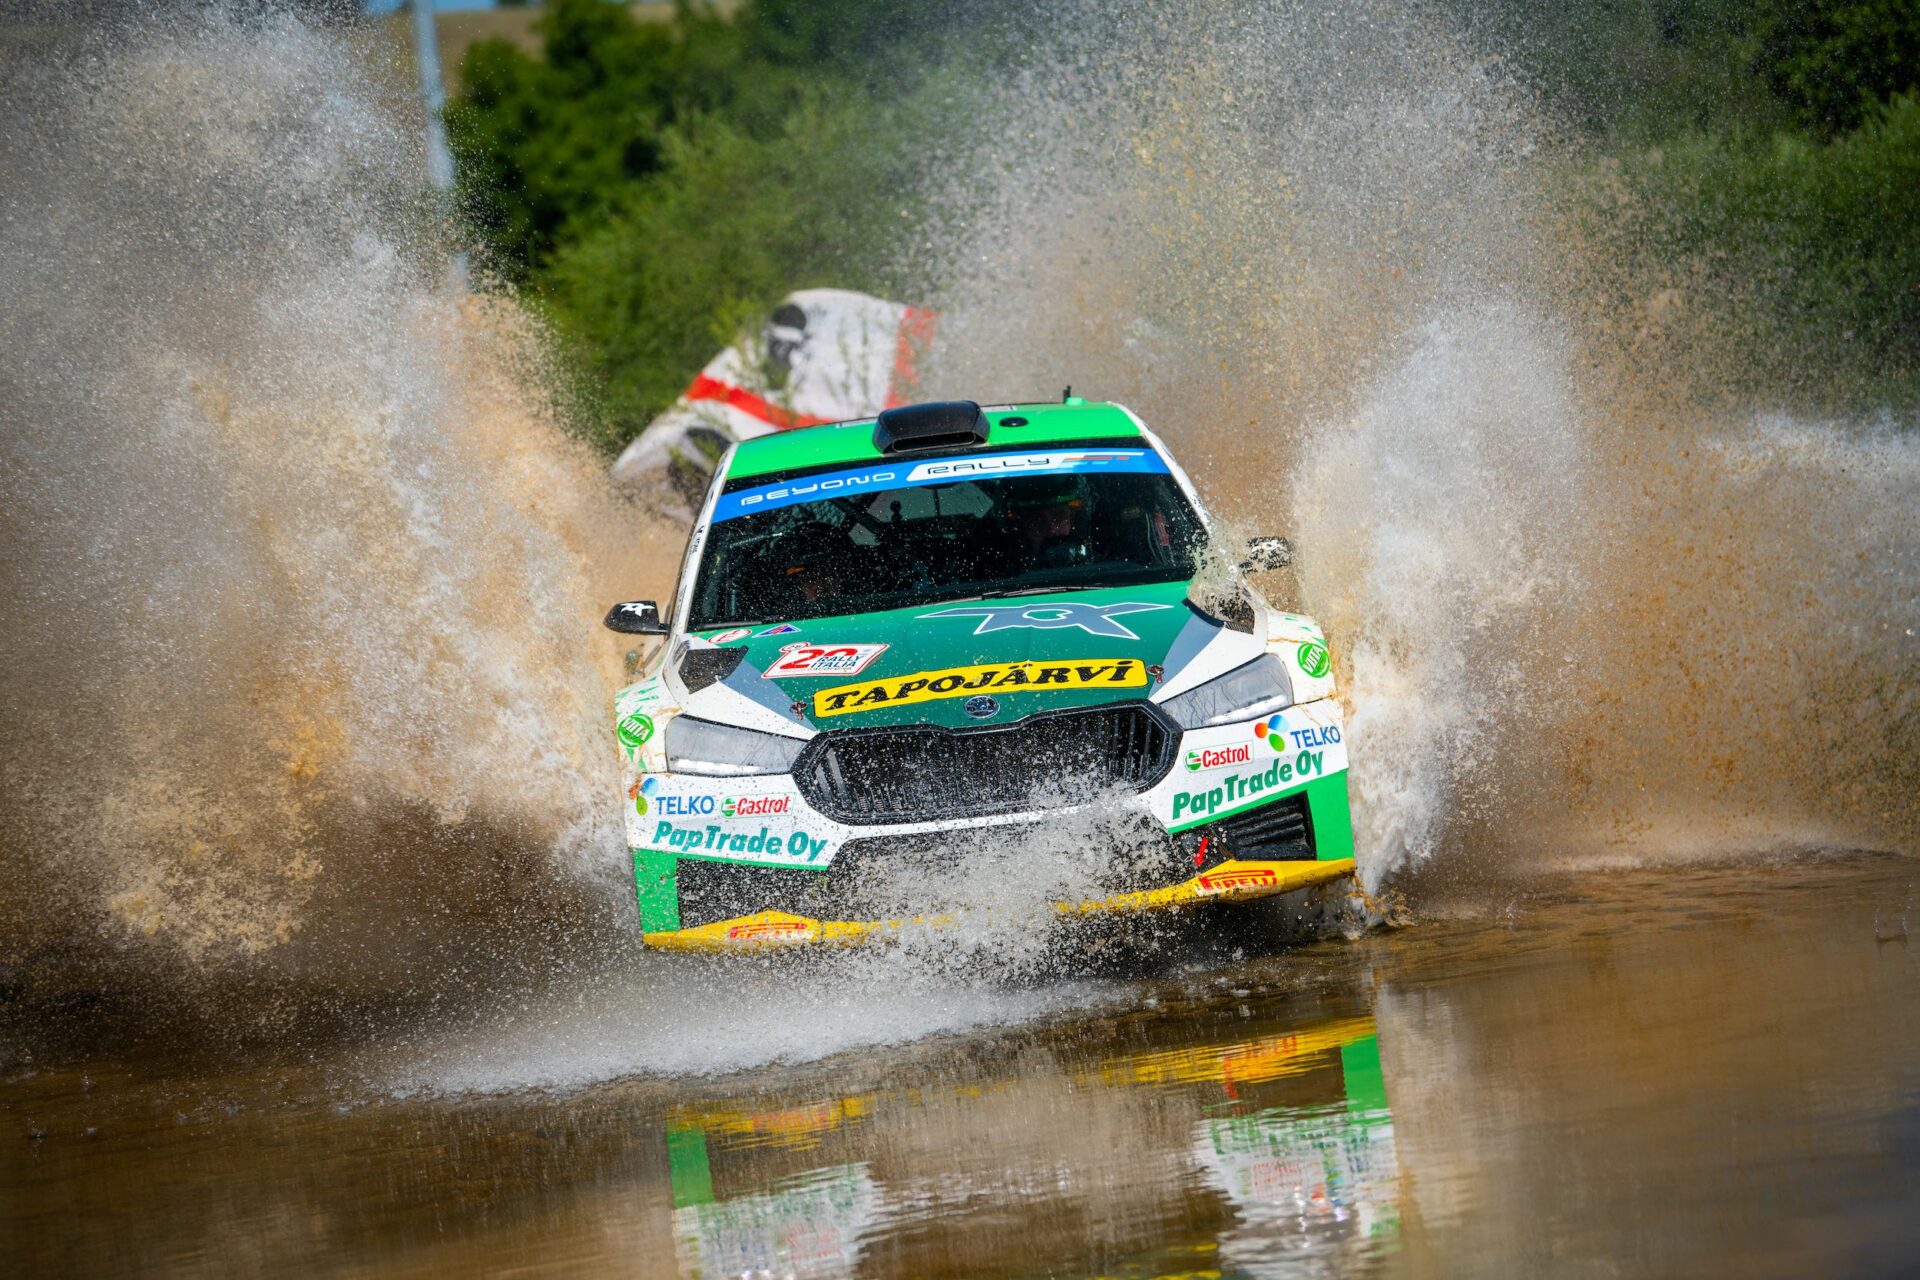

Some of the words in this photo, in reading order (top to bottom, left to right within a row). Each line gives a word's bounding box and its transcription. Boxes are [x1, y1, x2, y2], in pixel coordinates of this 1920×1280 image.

[740, 471, 896, 507] BEYOND
[926, 457, 1051, 476] RALLY
[810, 661, 857, 669] ITALIA
[817, 655, 862, 663] RALLY
[1290, 725, 1341, 749] TELKO
[1202, 744, 1250, 768] Castrol
[1172, 758, 1293, 820] PapTrade
[1295, 749, 1324, 776] Oy
[655, 795, 715, 815] TELKO
[737, 796, 790, 816] Castrol
[652, 820, 783, 855] PapTrade
[787, 831, 828, 862] Oy
